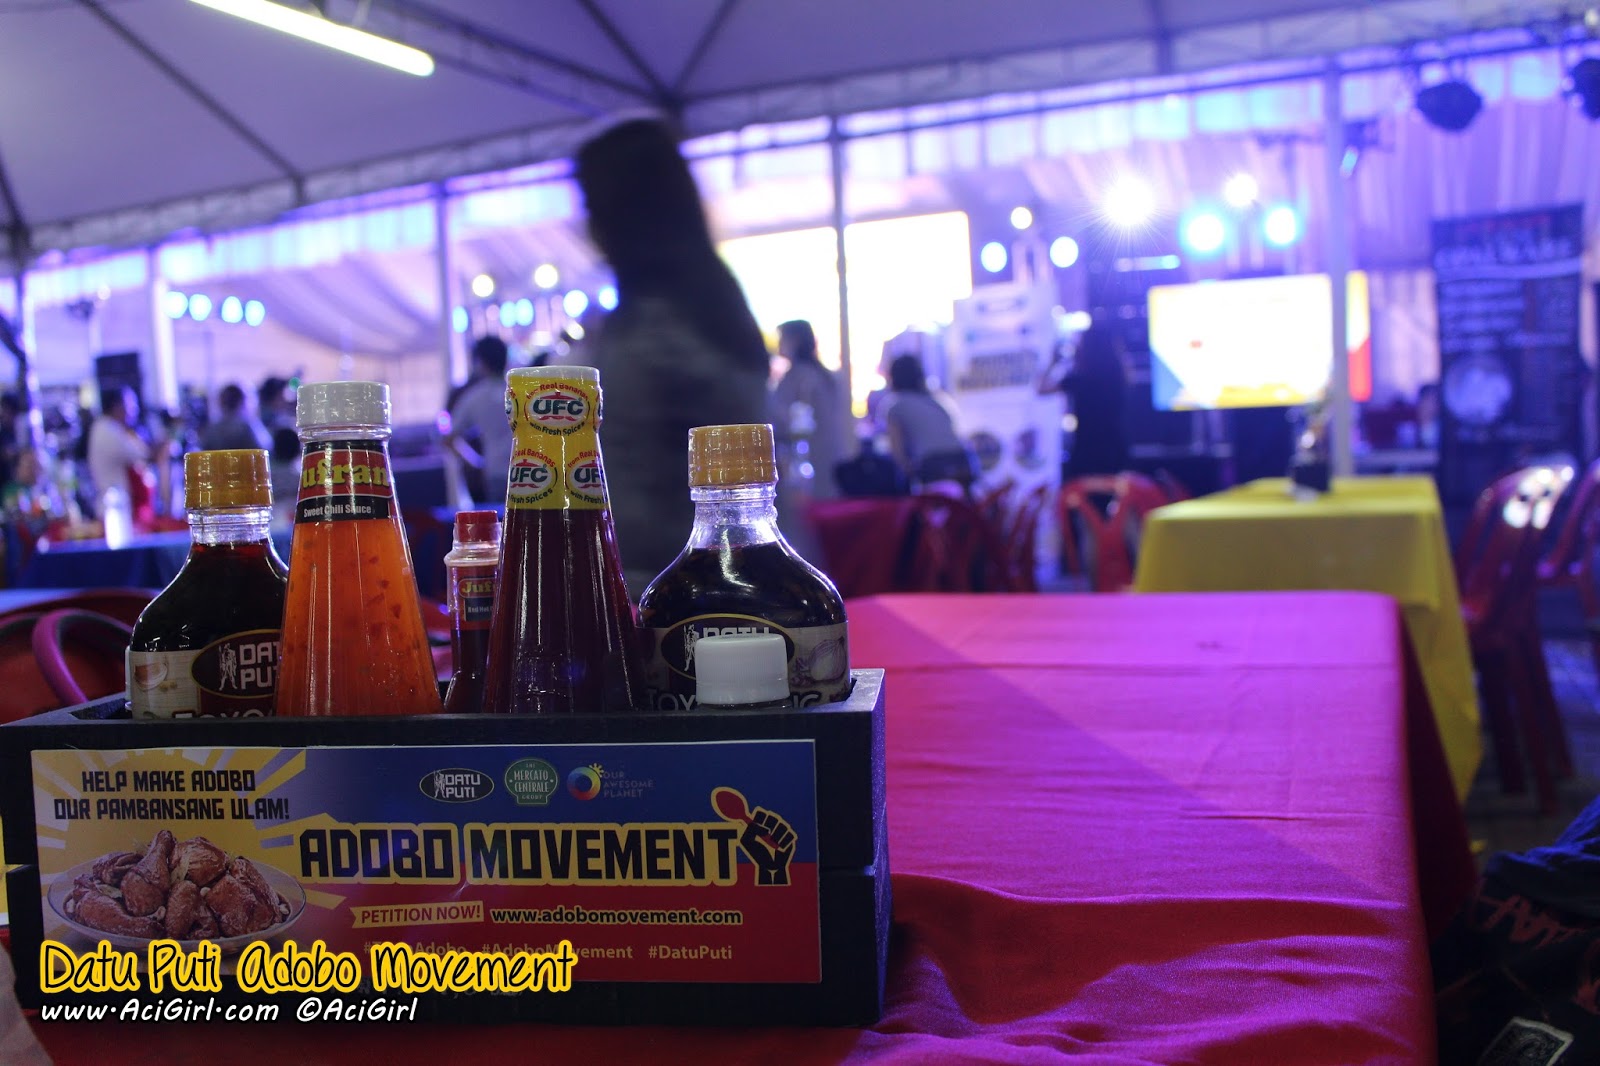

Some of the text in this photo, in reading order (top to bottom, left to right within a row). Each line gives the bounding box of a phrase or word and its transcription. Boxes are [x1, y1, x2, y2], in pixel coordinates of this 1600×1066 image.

[540, 382, 558, 392] Real
[559, 383, 588, 401] Bananas
[532, 399, 584, 416] UFC
[541, 426, 562, 436] Fresh
[562, 421, 585, 436] Spices
[527, 448, 556, 468] Bananas
[567, 456, 581, 468] from
[579, 450, 594, 459] Real
[301, 458, 390, 488] ufran
[573, 467, 605, 483] UF
[525, 488, 553, 504] Spices
[570, 489, 601, 504] with Fresh
[303, 506, 324, 518] Sweet
[324, 504, 344, 515] Chili
[461, 581, 496, 593] Juf
[239, 641, 280, 665] DAT
[240, 666, 279, 690] PU
[648, 688, 696, 711] TOY
[82, 769, 256, 793] HELP MAKE ADOBO
[445, 773, 481, 787] DATU
[513, 769, 549, 781] MERCATO
[603, 771, 625, 779] OUR
[603, 779, 654, 788] AWESOME
[445, 786, 475, 798] PUTI
[514, 781, 549, 793] CENTRALE
[603, 788, 644, 798] PLANET
[54, 797, 290, 821] OUR PAMBANSANG ULAM!
[300, 827, 738, 881] ADOBO MOVEMENT
[360, 905, 482, 925] PETITION NOW!
[490, 907, 743, 925] www.adobomovement.com
[481, 942, 633, 960] #AdoboMvement
[648, 945, 733, 960] #DatuPuti
